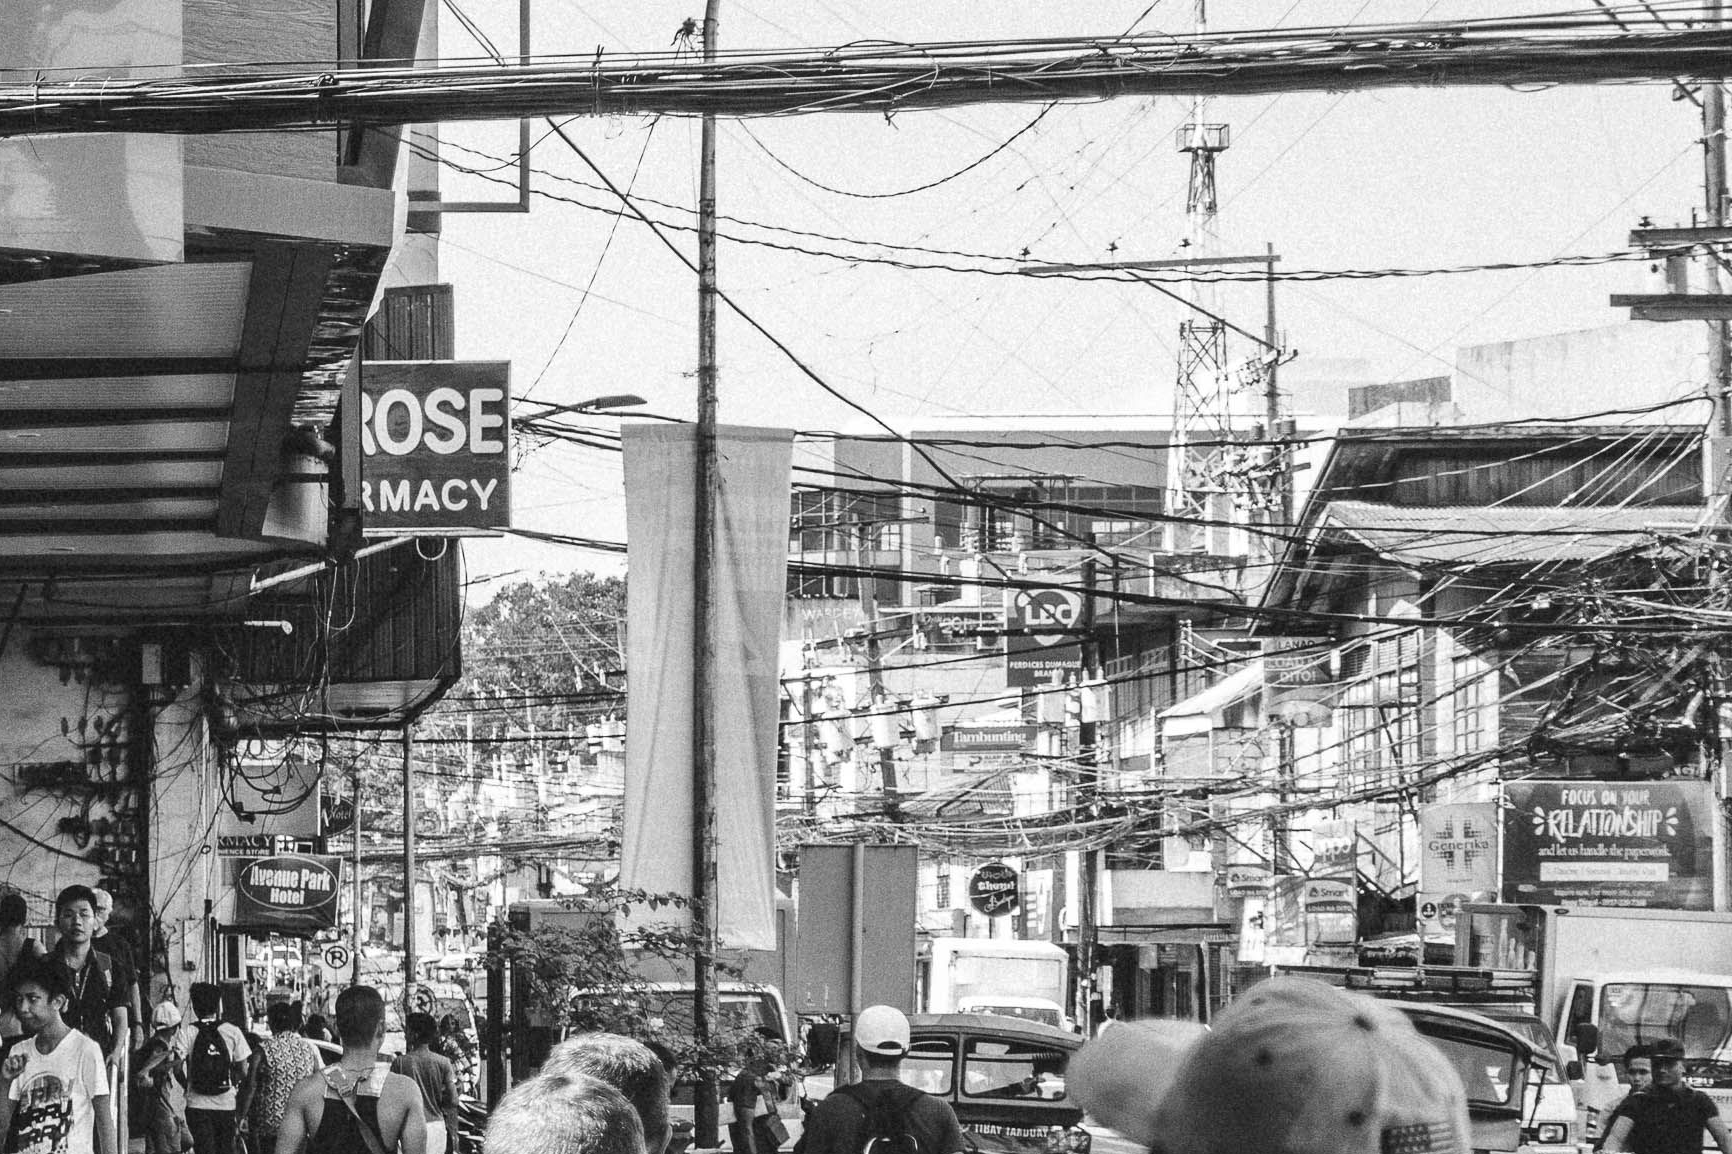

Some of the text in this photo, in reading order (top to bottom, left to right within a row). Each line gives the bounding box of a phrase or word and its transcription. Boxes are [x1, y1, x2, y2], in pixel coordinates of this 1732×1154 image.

[952, 731, 1027, 746] Tambunting
[1561, 789, 1650, 805] FOCUS ON YOUR
[1547, 805, 1664, 843] RELATIONSHIP
[1429, 838, 1489, 851] Generika
[250, 865, 331, 891] Avenue Park
[270, 887, 305, 905] Hotel
[1320, 889, 1349, 897] Smart
[975, 1123, 1002, 1135] TIBAY
